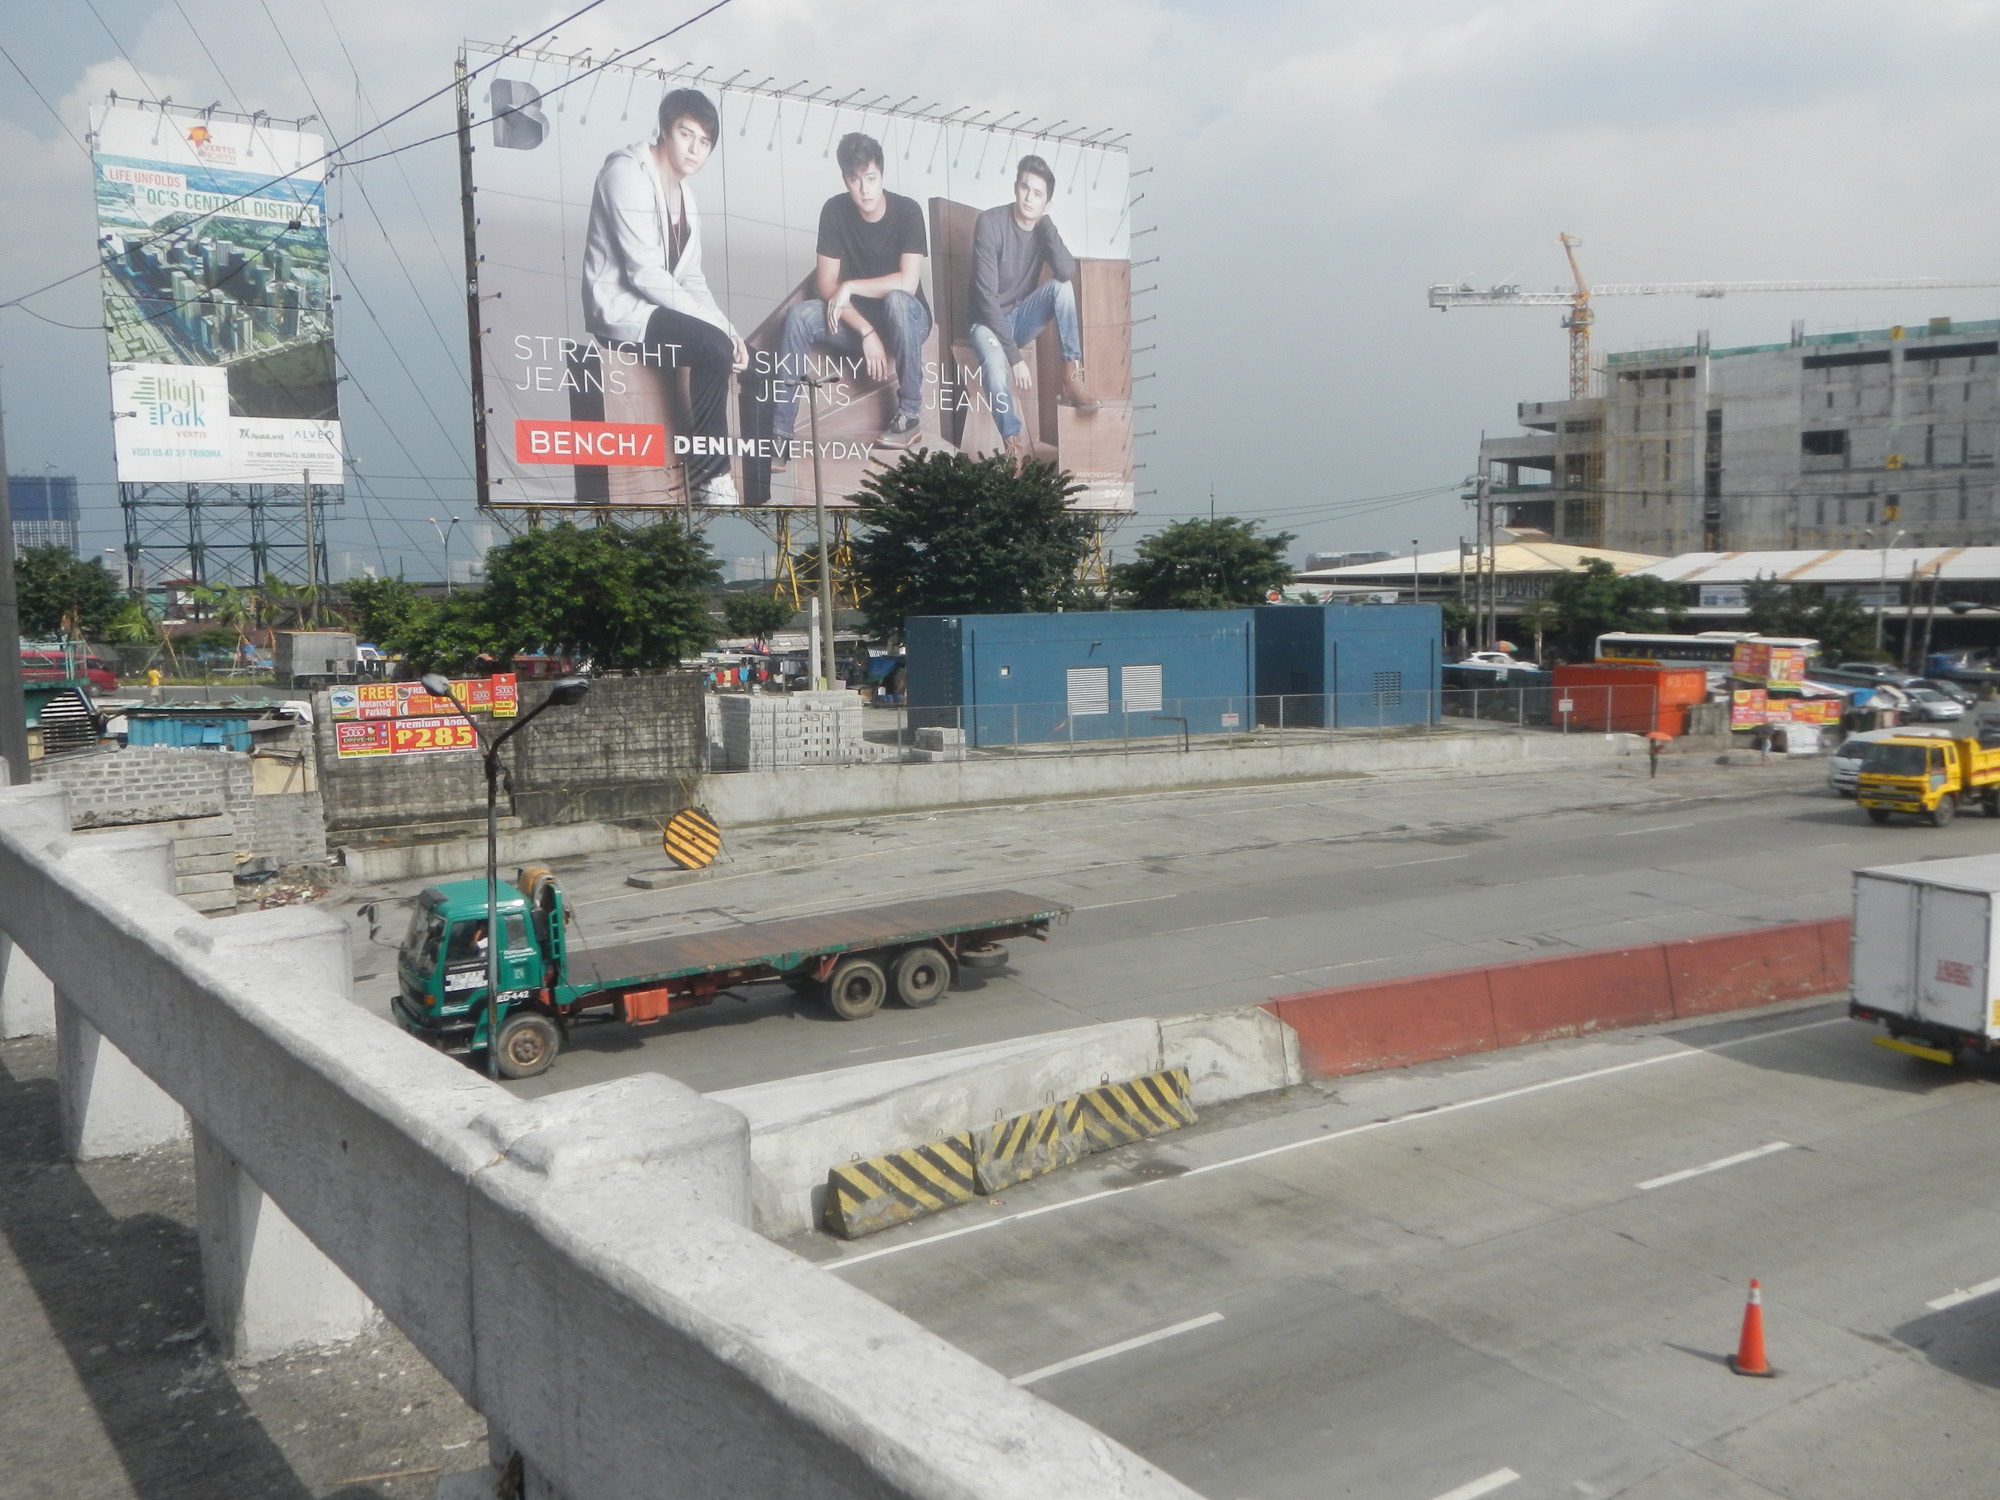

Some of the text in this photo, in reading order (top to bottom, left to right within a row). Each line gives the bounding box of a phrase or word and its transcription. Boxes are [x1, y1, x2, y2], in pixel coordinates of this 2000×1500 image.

[203, 144, 236, 155] VERTIS
[109, 169, 181, 188] LIFE UNFOLDS
[147, 188, 180, 208] QC'S
[185, 193, 249, 216] CENTRAL
[254, 201, 315, 223] DISTRICT
[514, 335, 682, 368] STRAIGHT
[755, 350, 864, 379] SKINNY
[925, 362, 984, 387] SLIM
[515, 366, 627, 395] JEANS
[158, 378, 204, 408] High
[756, 379, 851, 406] JEANS
[925, 389, 1010, 414] JEANS
[160, 402, 206, 427] Park
[176, 431, 207, 439] VERTIS
[294, 430, 335, 440] ALVEO
[132, 448, 150, 457] VISIT
[153, 448, 163, 457] US
[164, 449, 173, 457] AT
[189, 449, 221, 458] TRINOMA
[360, 686, 394, 700] FREE
[360, 699, 396, 709] Motorcycle
[365, 708, 392, 718] Parking
[395, 720, 441, 729] Premium
